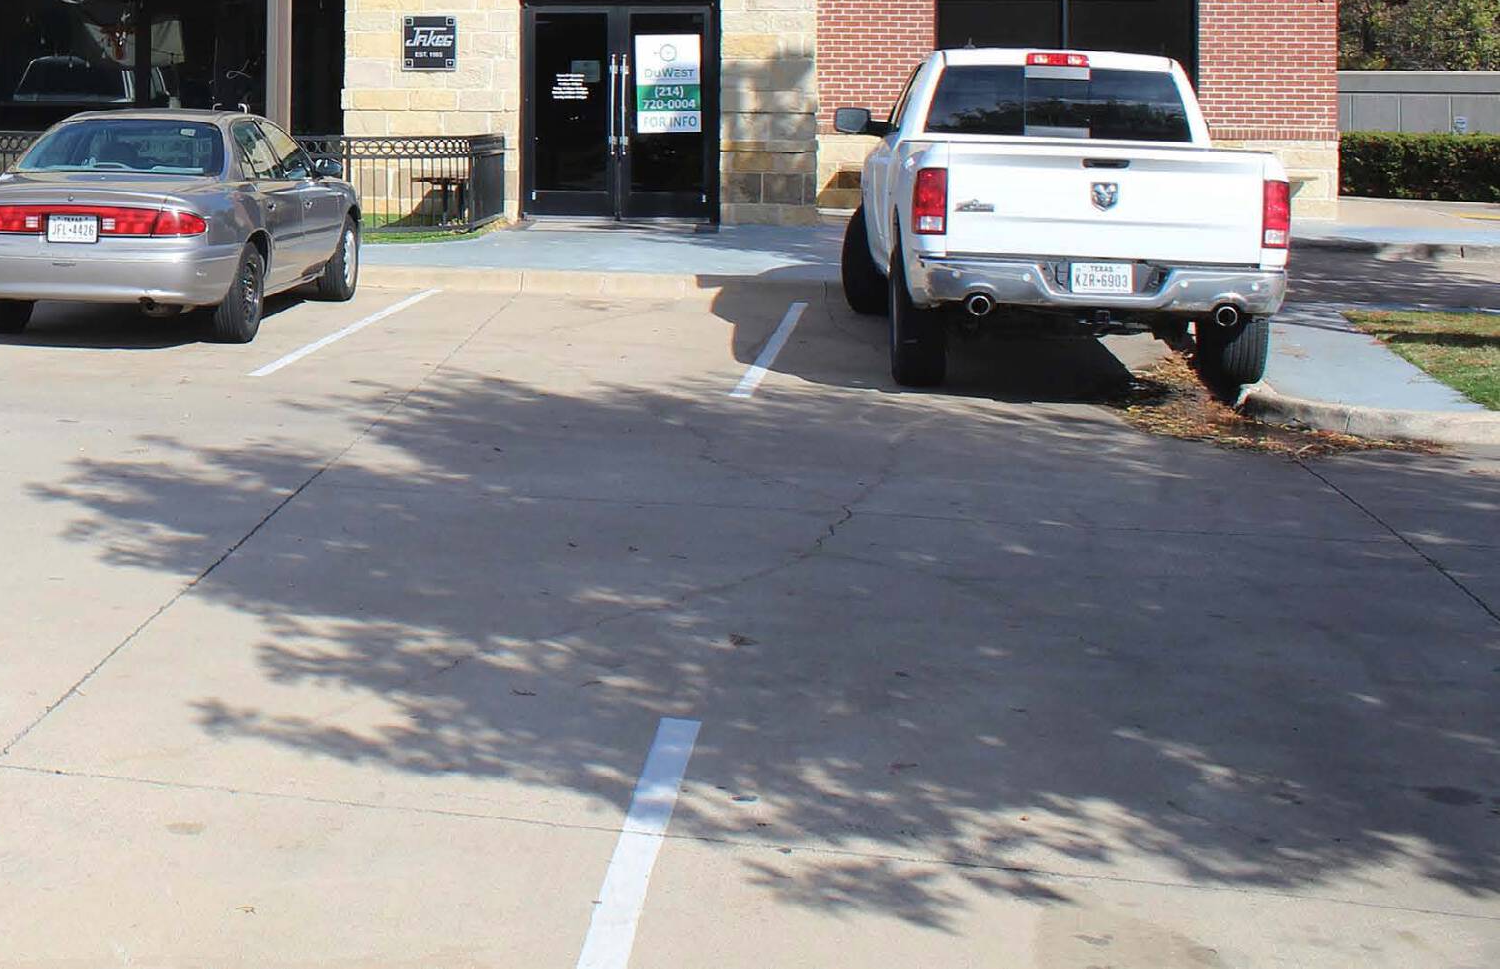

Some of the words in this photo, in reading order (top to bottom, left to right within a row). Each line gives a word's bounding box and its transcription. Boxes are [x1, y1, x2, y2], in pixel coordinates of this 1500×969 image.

[654, 86, 684, 98] (214)
[643, 99, 696, 110] 720-0004
[643, 116, 667, 127] FOR
[669, 115, 698, 127] INFO
